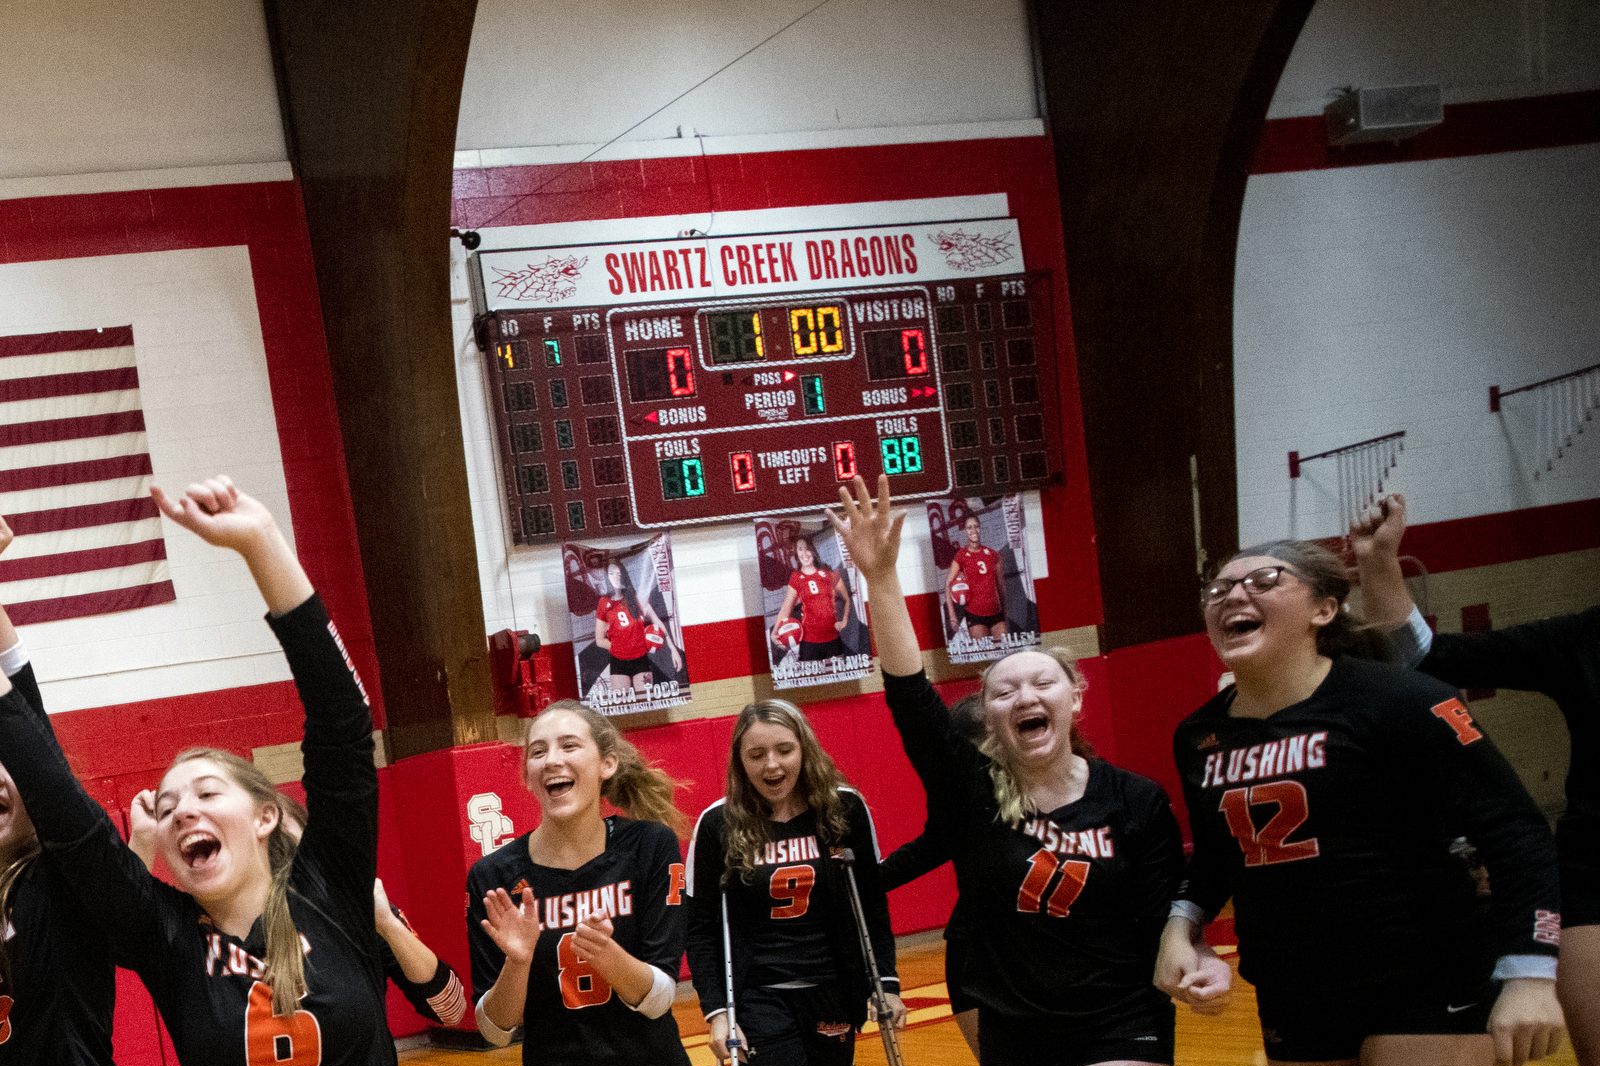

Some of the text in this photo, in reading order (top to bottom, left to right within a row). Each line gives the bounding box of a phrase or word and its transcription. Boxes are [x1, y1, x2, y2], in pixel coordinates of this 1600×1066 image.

[605, 233, 919, 296] SWARTZ CREEK DRAGONS
[936, 280, 1026, 302] NO F PTS
[543, 317, 553, 333] F
[572, 313, 600, 330] PTS
[854, 297, 926, 323] VISITOR
[624, 316, 684, 342] HOME
[545, 340, 560, 364] 7
[901, 329, 927, 375] 0
[667, 348, 695, 396] 0
[754, 372, 781, 385] POSS
[745, 390, 796, 410] PERIOD
[814, 377, 825, 412] 1
[862, 387, 908, 406] BONUS
[658, 406, 707, 426] BONUS
[876, 416, 918, 435] FOULS
[655, 438, 701, 458] FOULS
[758, 447, 827, 468] TIMEOUTS
[835, 442, 857, 479] 0
[882, 436, 922, 474] 88
[683, 459, 705, 496] 0
[732, 453, 755, 490] 0
[778, 467, 811, 485] LEFT
[977, 561, 988, 574] 3
[808, 580, 819, 594] 8
[617, 611, 630, 627] 9
[1001, 631, 1036, 650] ALLEN
[831, 653, 871, 674] TRAVIS
[588, 681, 680, 708] ALICIA TODD
[1430, 697, 1483, 746] F
[1201, 731, 1328, 789] FLUSHING
[1218, 780, 1320, 867] 12
[770, 864, 816, 919] 9
[1017, 848, 1091, 918] 11
[557, 932, 613, 1010] 8
